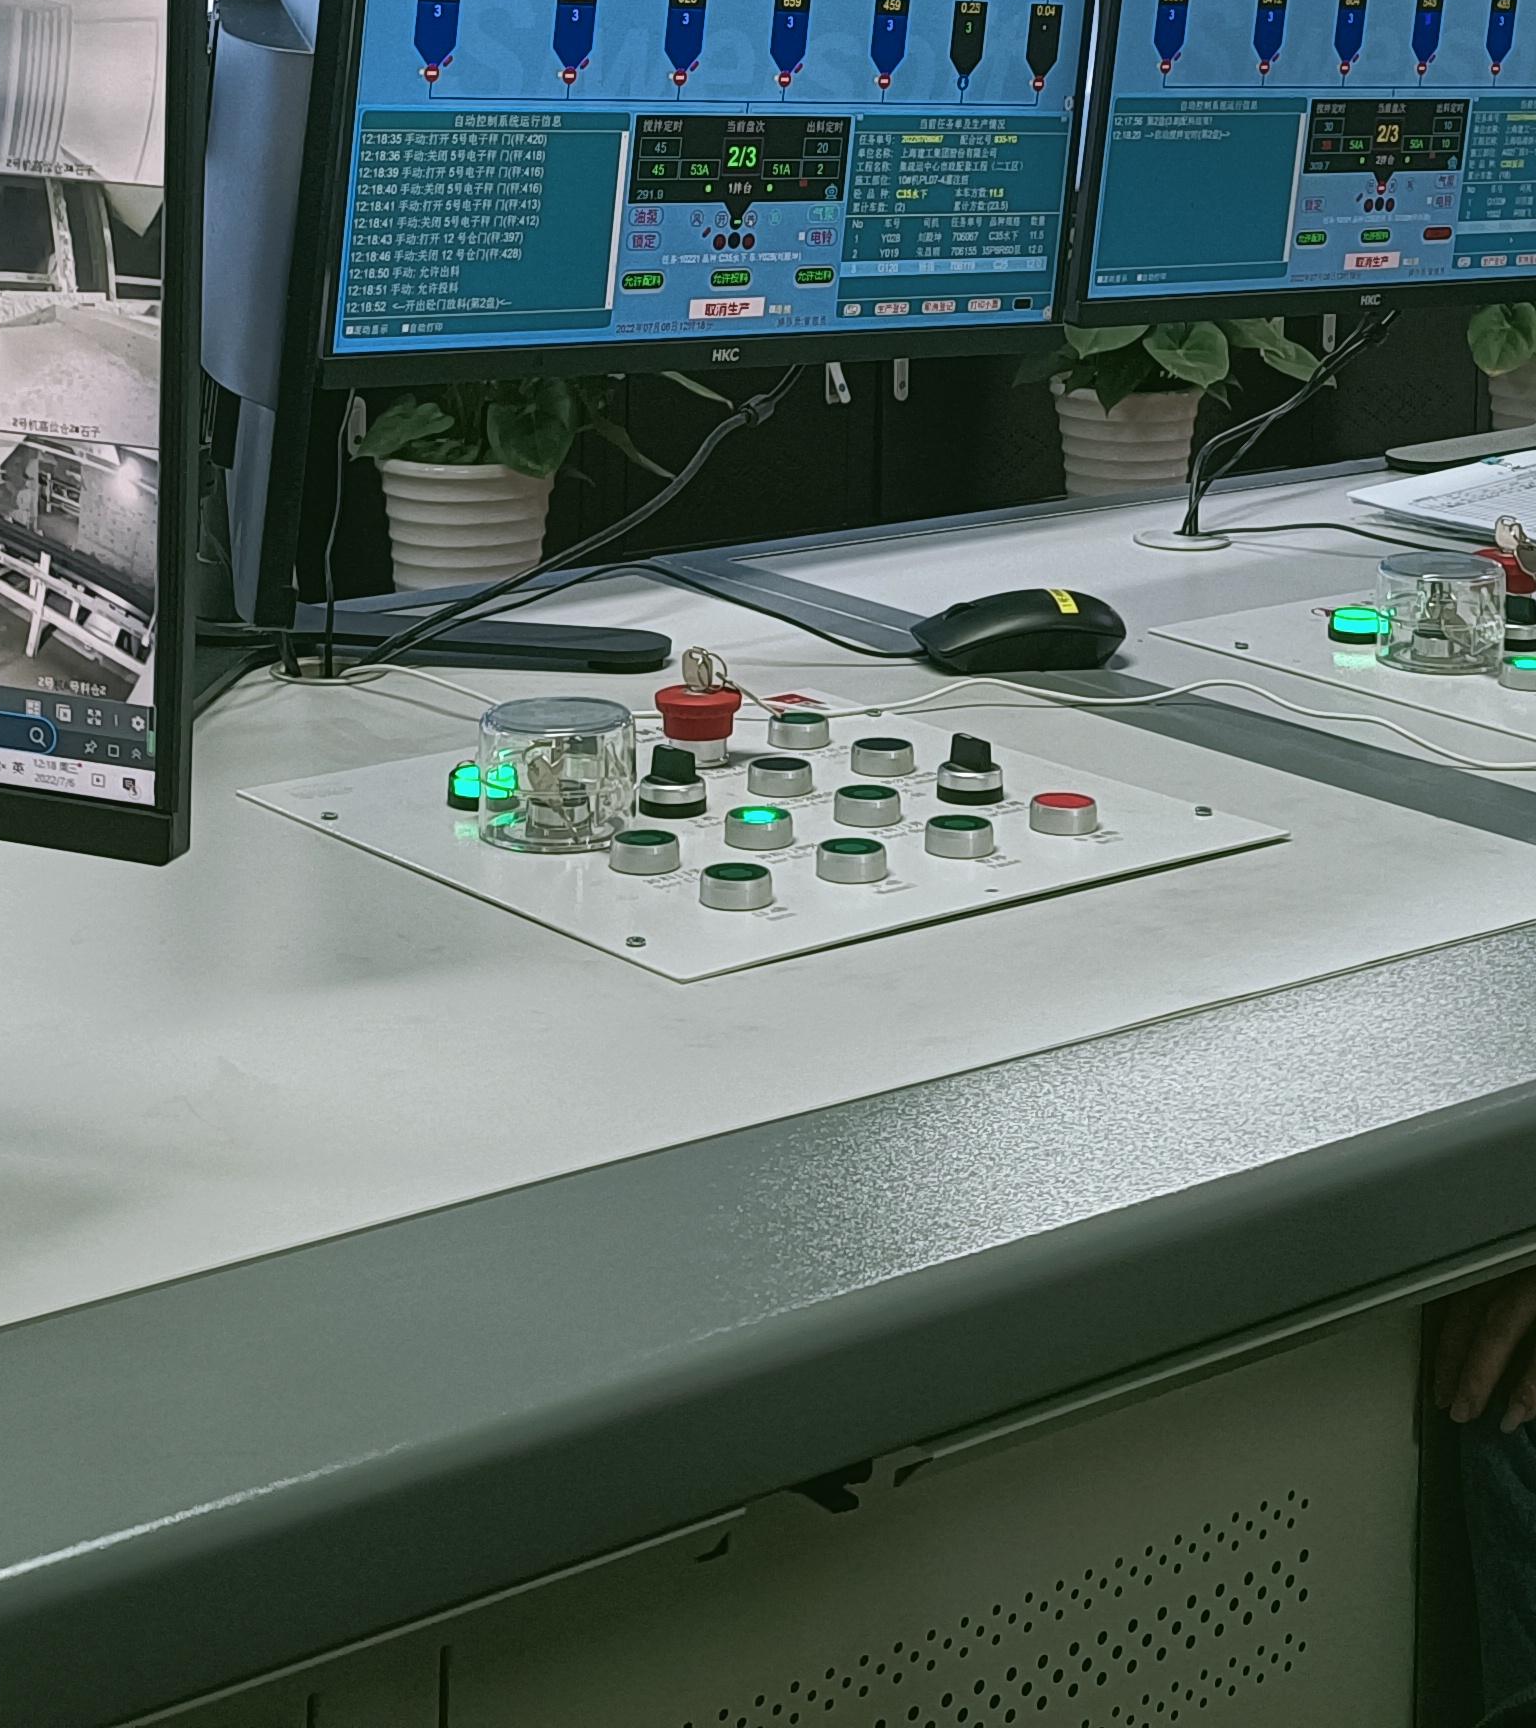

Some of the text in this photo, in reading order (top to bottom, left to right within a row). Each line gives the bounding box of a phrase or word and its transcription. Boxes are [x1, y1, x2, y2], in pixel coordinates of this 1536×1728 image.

[434, 5, 578, 21] 3 3
[883, 0, 901, 11] 459
[1037, 5, 1055, 17] 0.04
[727, 121, 765, 132] 当前盘次
[362, 134, 402, 144] 12:18:35
[1376, 124, 1399, 143] 2/3
[360, 151, 400, 161] 12:18:36
[655, 143, 828, 167] 45 2/3 20
[652, 164, 823, 175] 45 53A 51A 2
[352, 234, 392, 245] 12:18:43
[811, 231, 833, 244] 电铃
[1361, 294, 1381, 306] HKC
[705, 303, 750, 316] 取消生产
[712, 348, 740, 361] HKC
